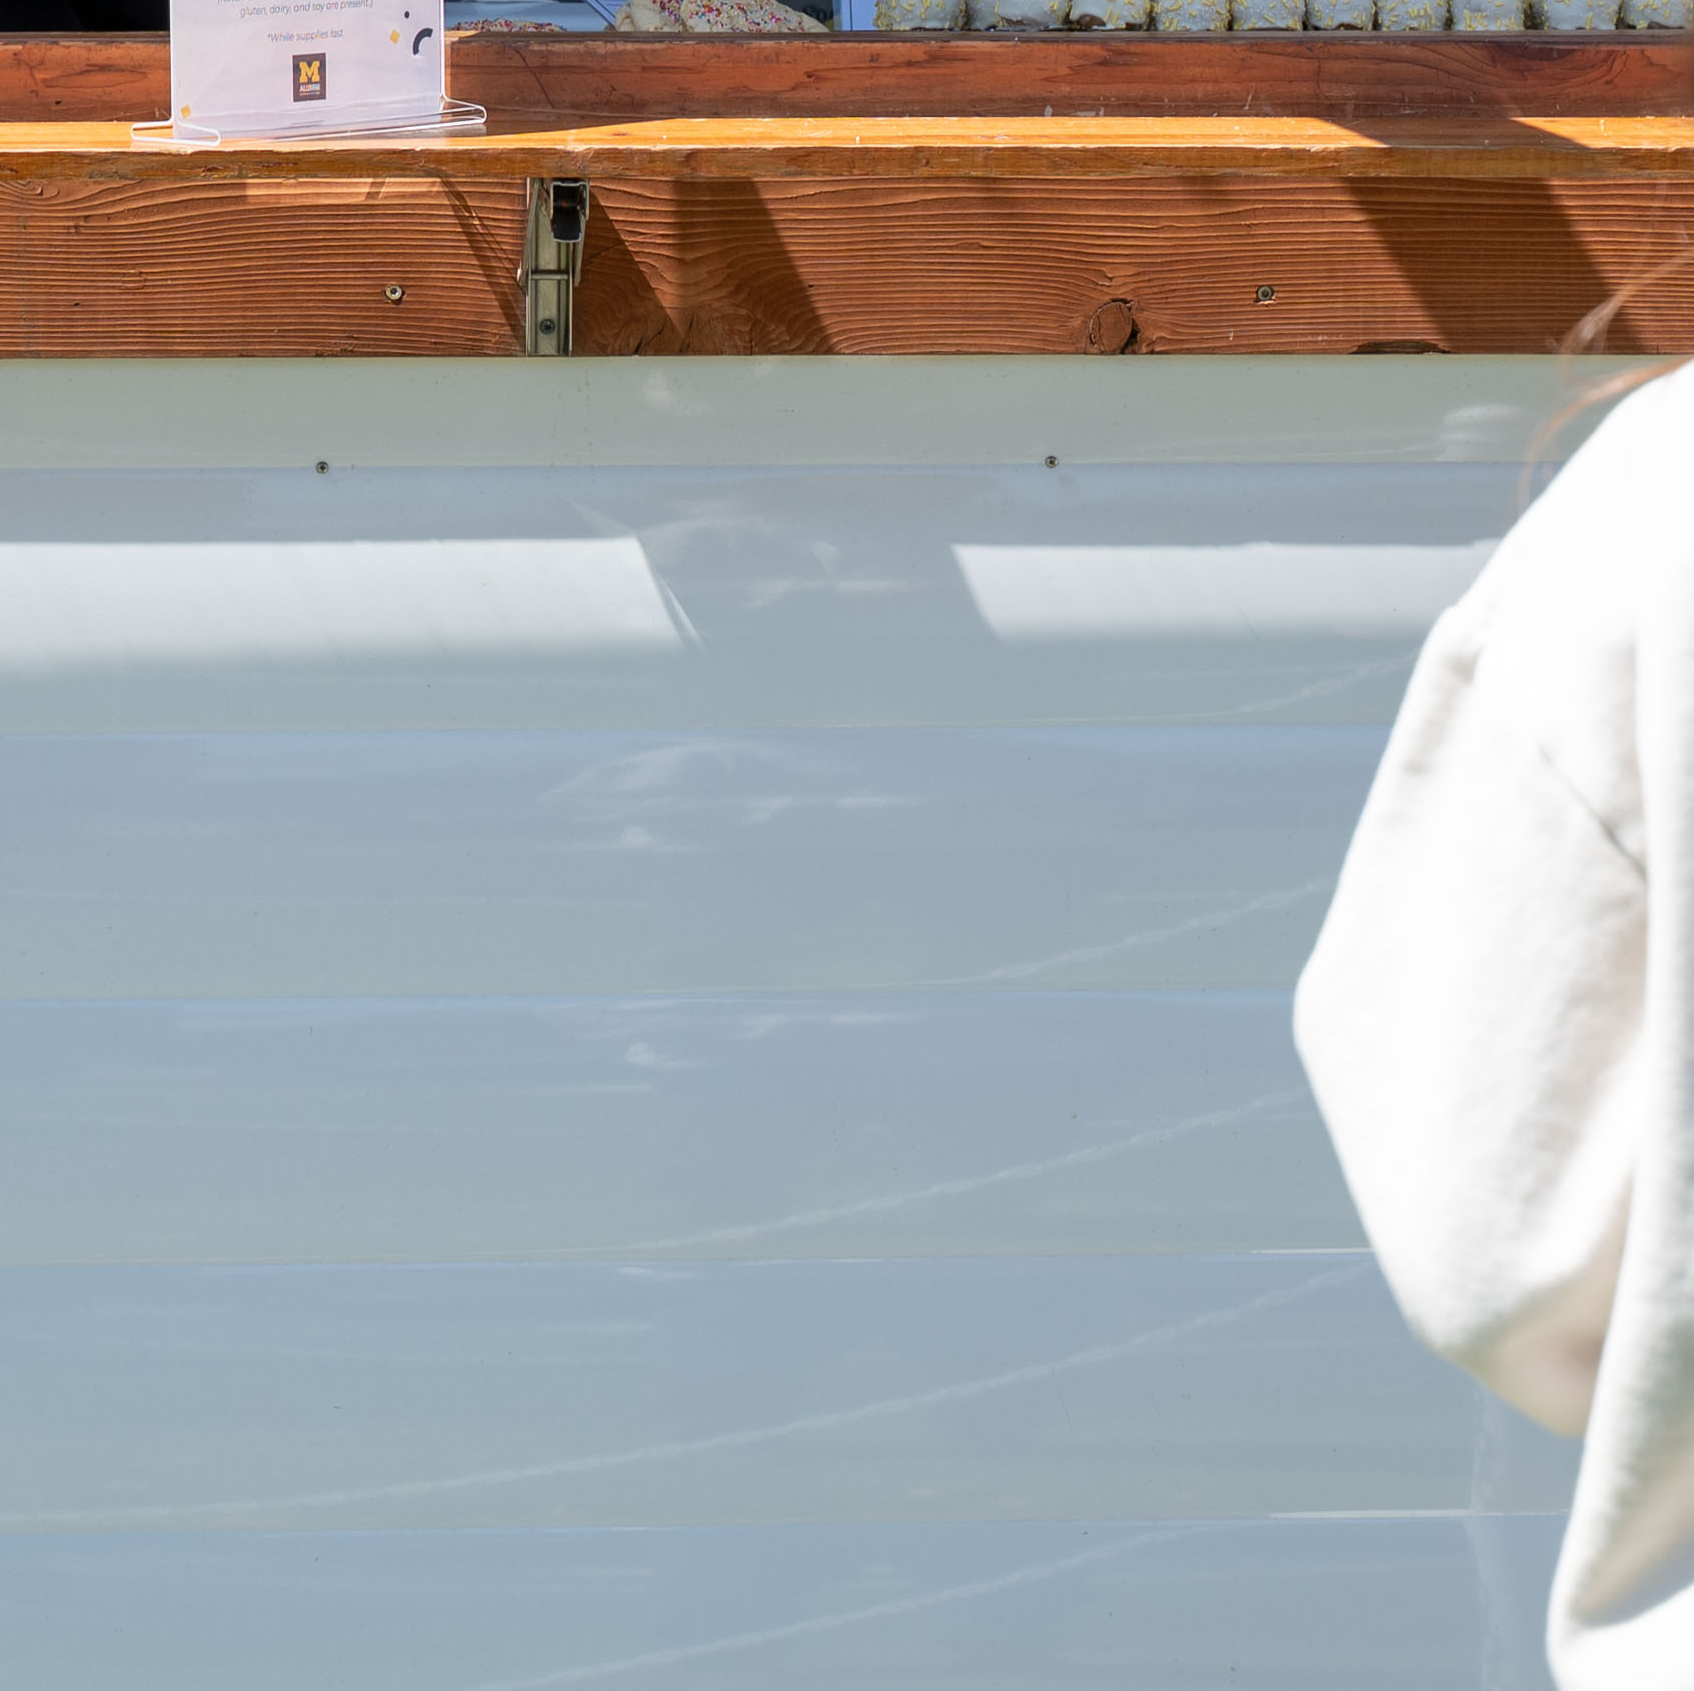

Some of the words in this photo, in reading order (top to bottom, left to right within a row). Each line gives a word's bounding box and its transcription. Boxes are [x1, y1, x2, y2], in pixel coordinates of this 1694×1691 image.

[293, 1, 311, 12] and
[312, 2, 325, 13] soy
[326, 1, 339, 10] are
[296, 29, 329, 42] supplies
[330, 28, 343, 39] last
[299, 60, 320, 83] M
